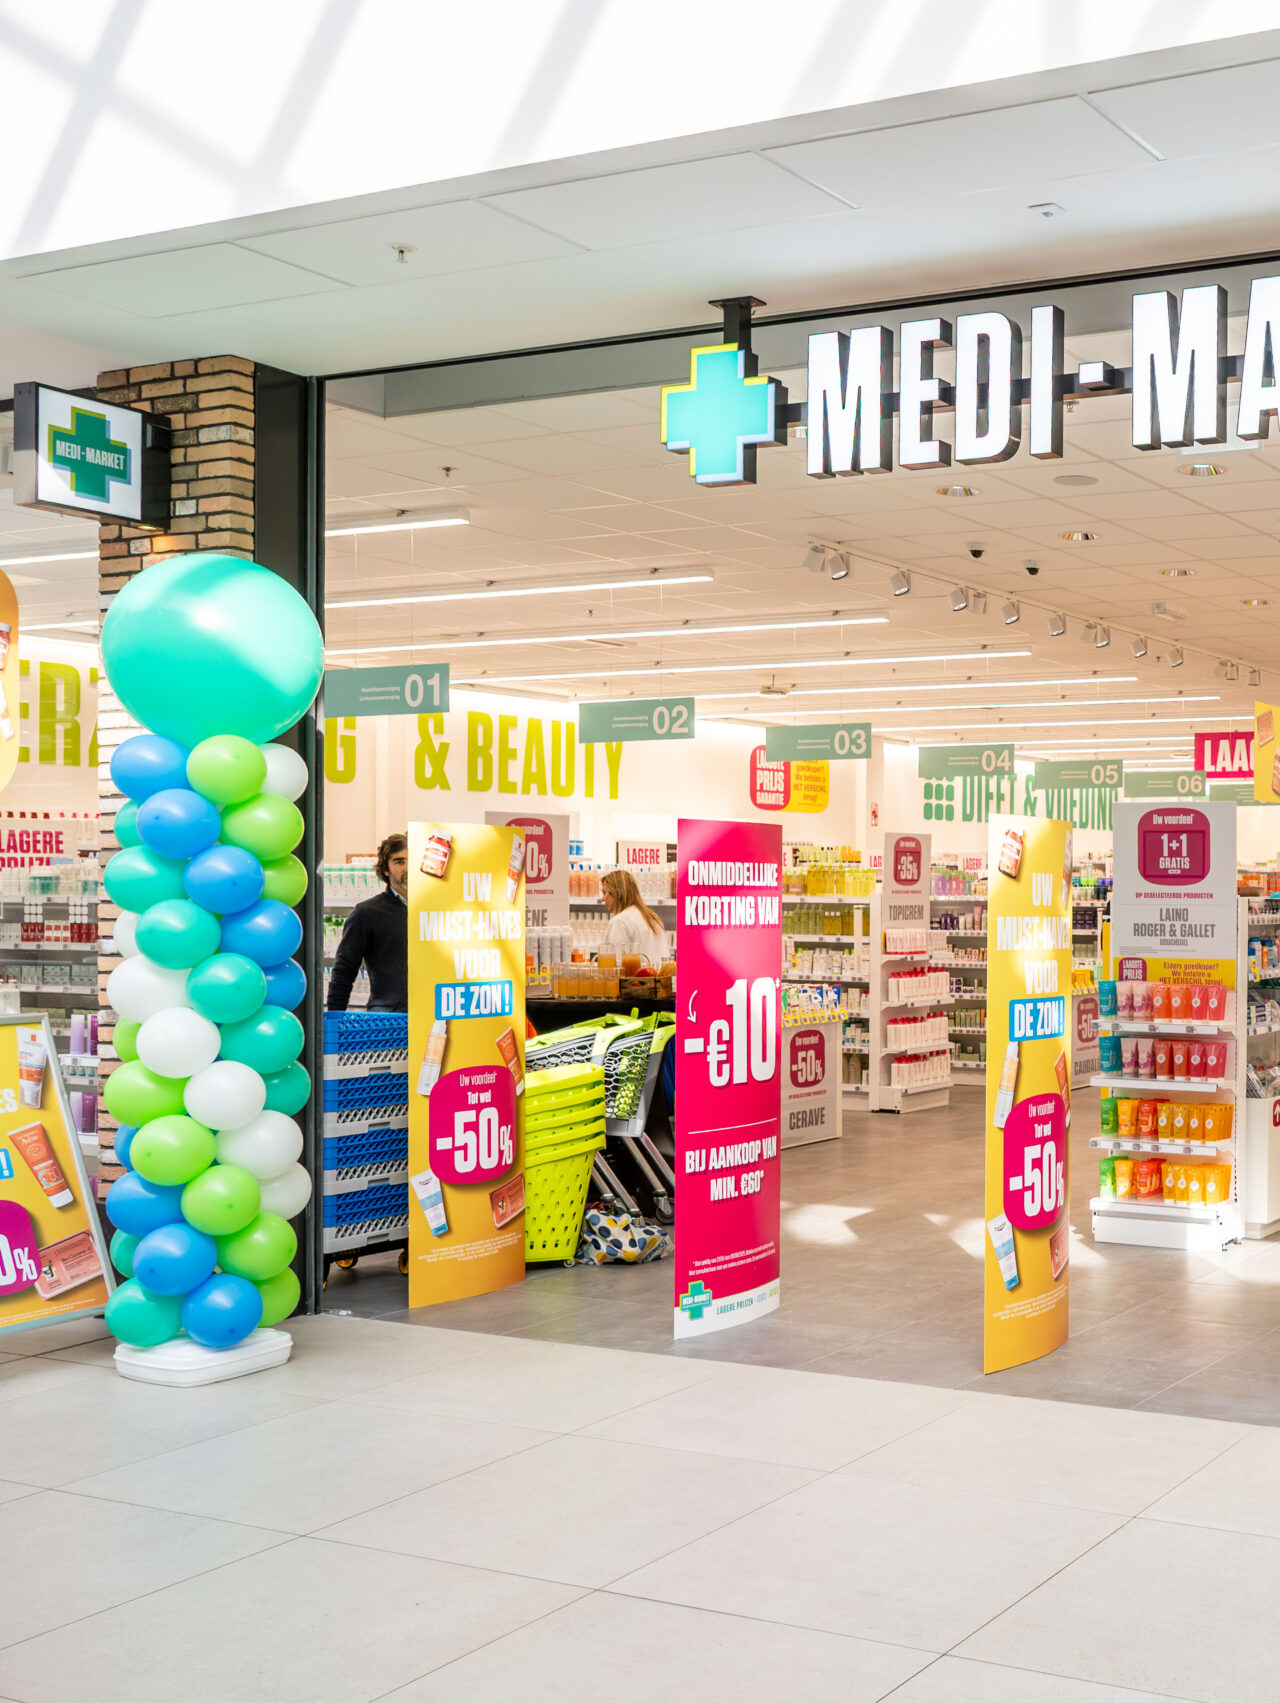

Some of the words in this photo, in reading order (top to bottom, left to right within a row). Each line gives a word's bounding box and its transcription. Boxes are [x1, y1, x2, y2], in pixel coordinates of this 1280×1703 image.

[404, 673, 441, 708] 01
[652, 705, 690, 735] 02
[834, 729, 867, 755] 03
[414, 713, 452, 790] &
[467, 711, 624, 800] BEAUTY
[981, 749, 1011, 772] 04
[1204, 739, 1254, 772] LAA
[756, 769, 785, 792] PRIJS
[1090, 764, 1119, 785] 05
[1177, 775, 1203, 793] 06
[1152, 813, 1164, 825] Uw
[626, 848, 660, 865] LAGERE
[1160, 833, 1188, 857] 1+1
[688, 860, 779, 887] ONMIDDELLIJKE
[1159, 857, 1190, 869] GRATIS
[462, 872, 492, 902] UW
[1032, 872, 1053, 906] UW
[684, 895, 755, 926] KORTING
[757, 896, 779, 925] VAN
[888, 904, 924, 921] TOPICREM
[1159, 907, 1189, 922] LAINO
[419, 909, 522, 941] MUST-HAVES
[997, 915, 1071, 951] MUST-HAVES
[1133, 922, 1167, 938] ROGER
[1169, 923, 1177, 938] &
[1180, 923, 1216, 939] GALLET
[452, 948, 501, 980] VOOR
[1122, 959, 1143, 969] LAAGSTE
[1122, 969, 1143, 980] PRIJS
[1163, 962, 1182, 970] Elders
[1183, 962, 1219, 971] goedkoper?
[1182, 970, 1206, 978] betalen
[1024, 959, 1058, 995] VOOR
[1171, 977, 1203, 985] VERSCHIL
[441, 986, 466, 1017] DE
[1013, 1002, 1034, 1038] DE
[1078, 1013, 1098, 1039] -50
[791, 1049, 823, 1083] -50%
[459, 1073, 470, 1087] Uw
[467, 1091, 479, 1105] Tot
[479, 1089, 492, 1104] wel
[789, 1106, 826, 1131] CERAVE
[1028, 1102, 1037, 1118] Uw
[436, 1106, 513, 1174] -50%
[1034, 1122, 1043, 1138] Tot
[1043, 1120, 1052, 1137] wel
[685, 1148, 706, 1174] BIJ
[708, 1141, 763, 1170] AANKOOP
[762, 1135, 778, 1160] VAN
[710, 1176, 739, 1202] MIN.
[1009, 1140, 1065, 1217] -50%
[716, 1302, 736, 1316] LAGERE
